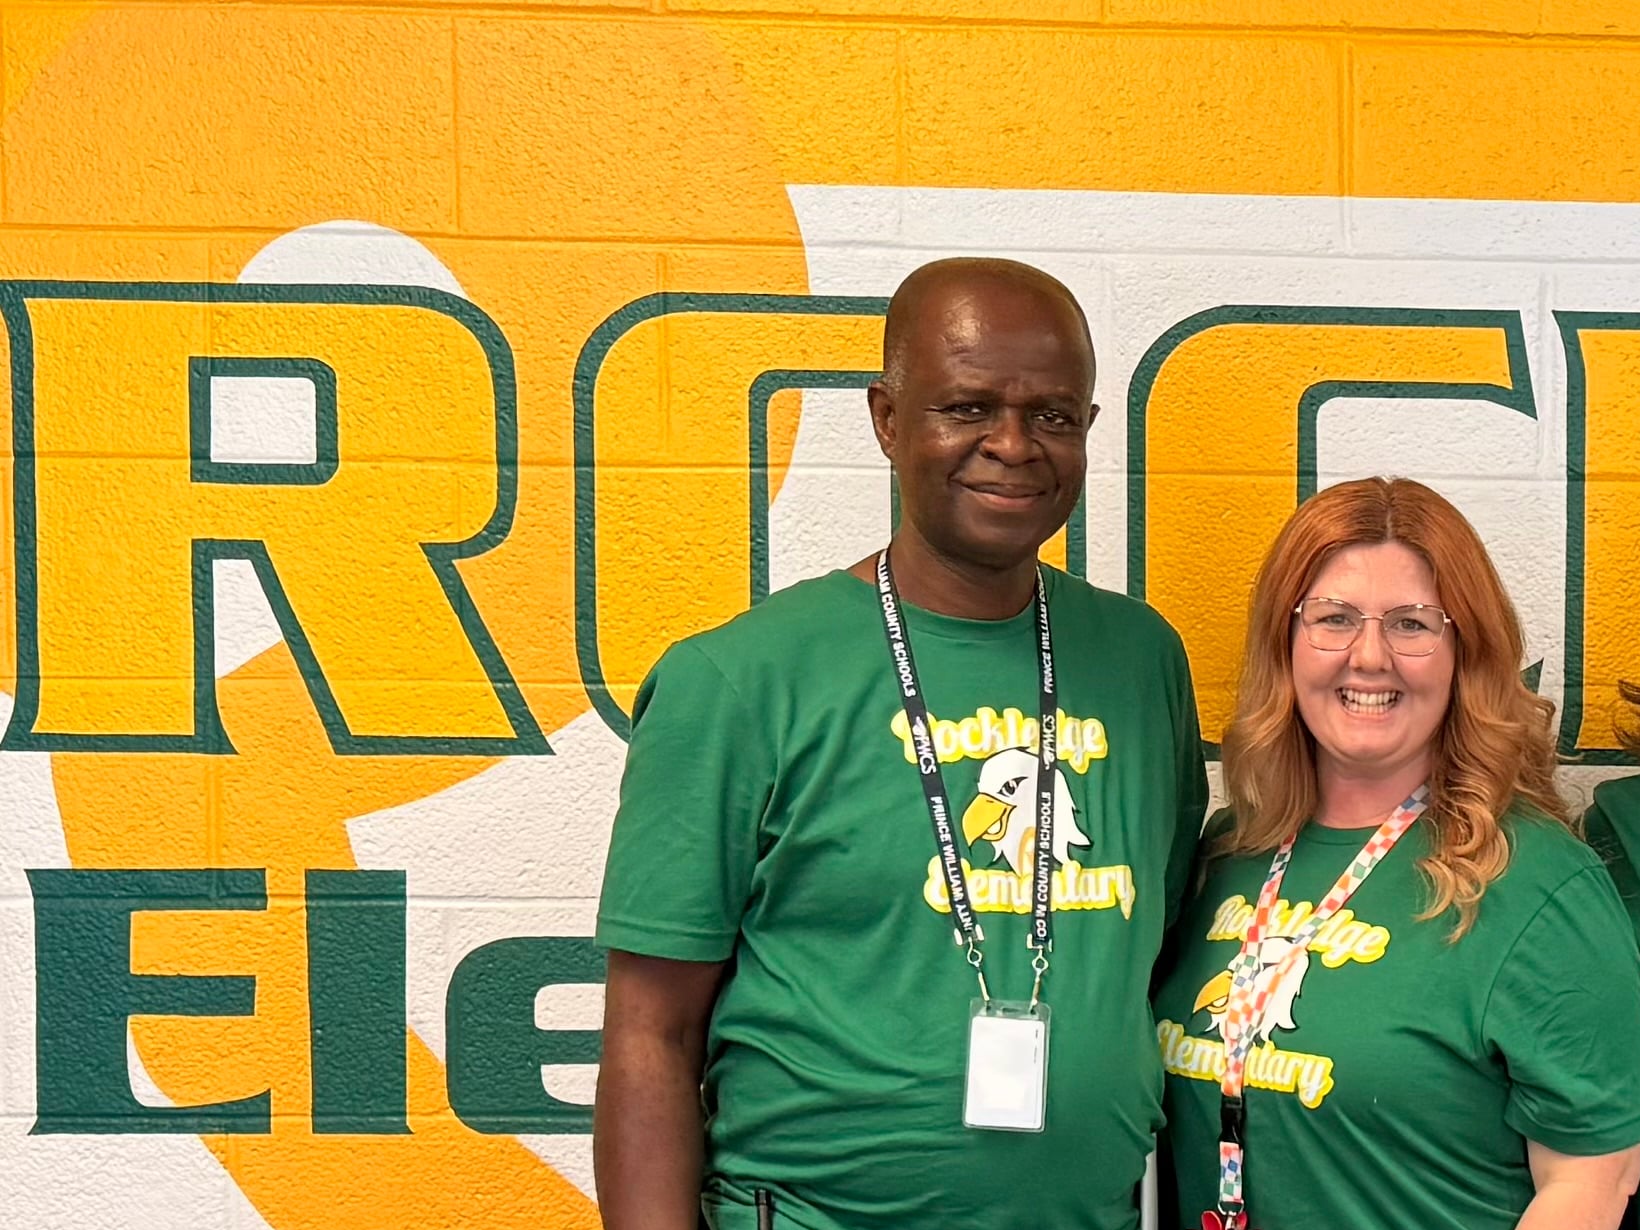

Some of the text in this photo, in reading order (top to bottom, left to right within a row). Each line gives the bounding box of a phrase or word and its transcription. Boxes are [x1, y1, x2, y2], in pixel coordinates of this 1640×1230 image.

[881, 593, 902, 640] COUNTY
[892, 641, 917, 698] SCHOOLS
[930, 795, 951, 843] PRINCE
[1039, 791, 1051, 850] SCHOOLS
[1037, 853, 1050, 901] COUNTY
